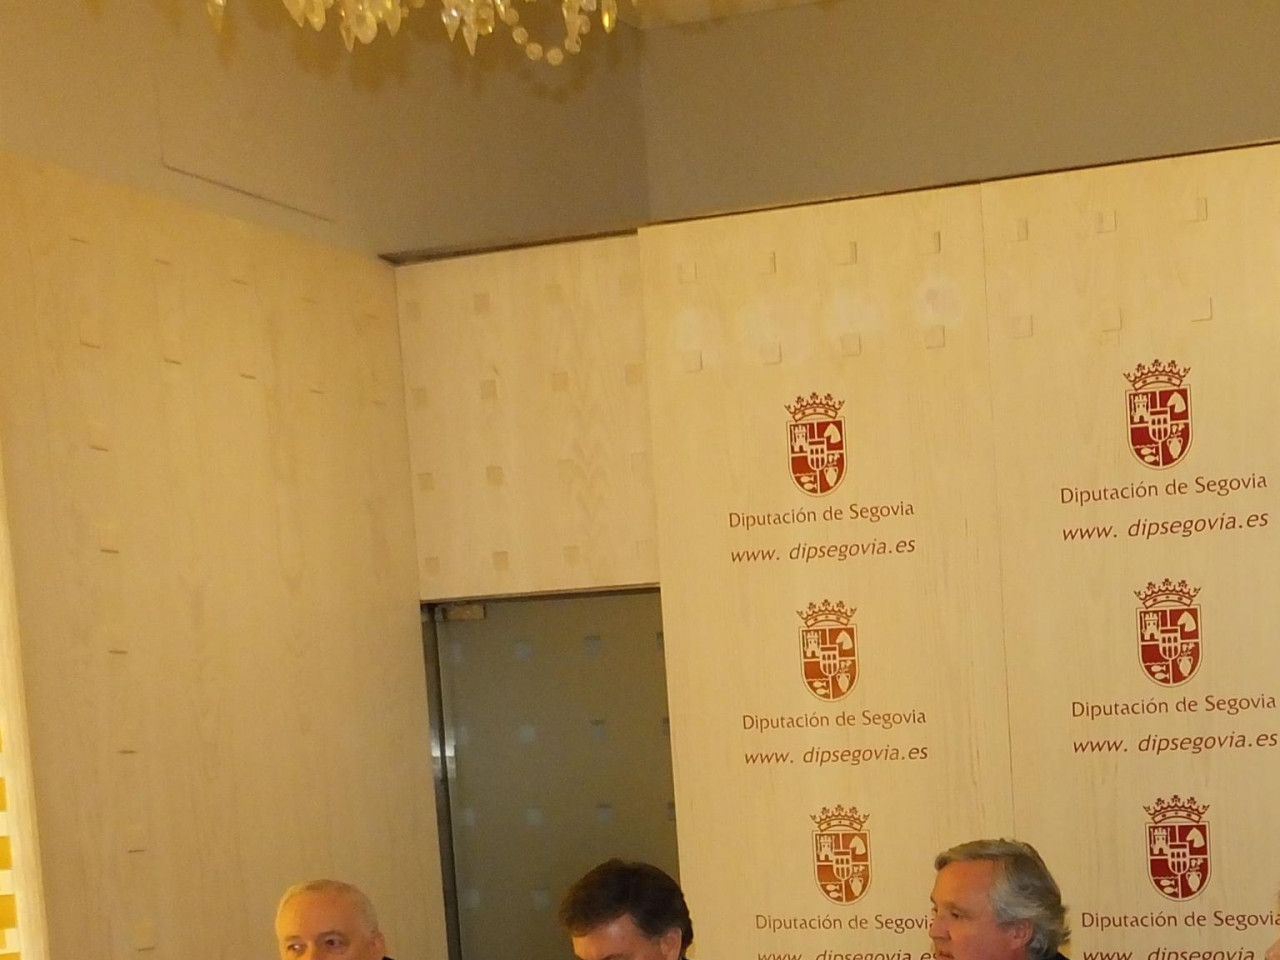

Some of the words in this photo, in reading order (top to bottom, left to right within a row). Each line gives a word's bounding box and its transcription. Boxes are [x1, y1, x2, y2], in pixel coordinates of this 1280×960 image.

[1061, 481, 1158, 507] Diputación
[1165, 479, 1188, 495] de
[1195, 473, 1267, 496] Segovia
[729, 508, 816, 530] Diputación
[823, 506, 843, 521] de
[850, 501, 914, 522] Segovia
[1063, 526, 1117, 541] www.
[1128, 513, 1268, 540] dipsegovia.es
[731, 549, 779, 562] www.
[790, 538, 915, 563] dipsegovia.es
[1072, 698, 1169, 721] Diputación
[1175, 697, 1198, 712] de
[1205, 694, 1276, 715] Segovia
[743, 712, 829, 731] Diputación
[836, 711, 855, 726] de
[862, 709, 926, 729] Segovia
[1074, 740, 1127, 753] www.
[1138, 731, 1277, 755] dipsegovia.es
[745, 752, 793, 764] www.
[803, 745, 928, 766] dipsegovia.es
[756, 915, 842, 933] Diputación
[848, 915, 868, 929] de
[1082, 911, 1177, 931] Diputación
[1184, 912, 1206, 926] de
